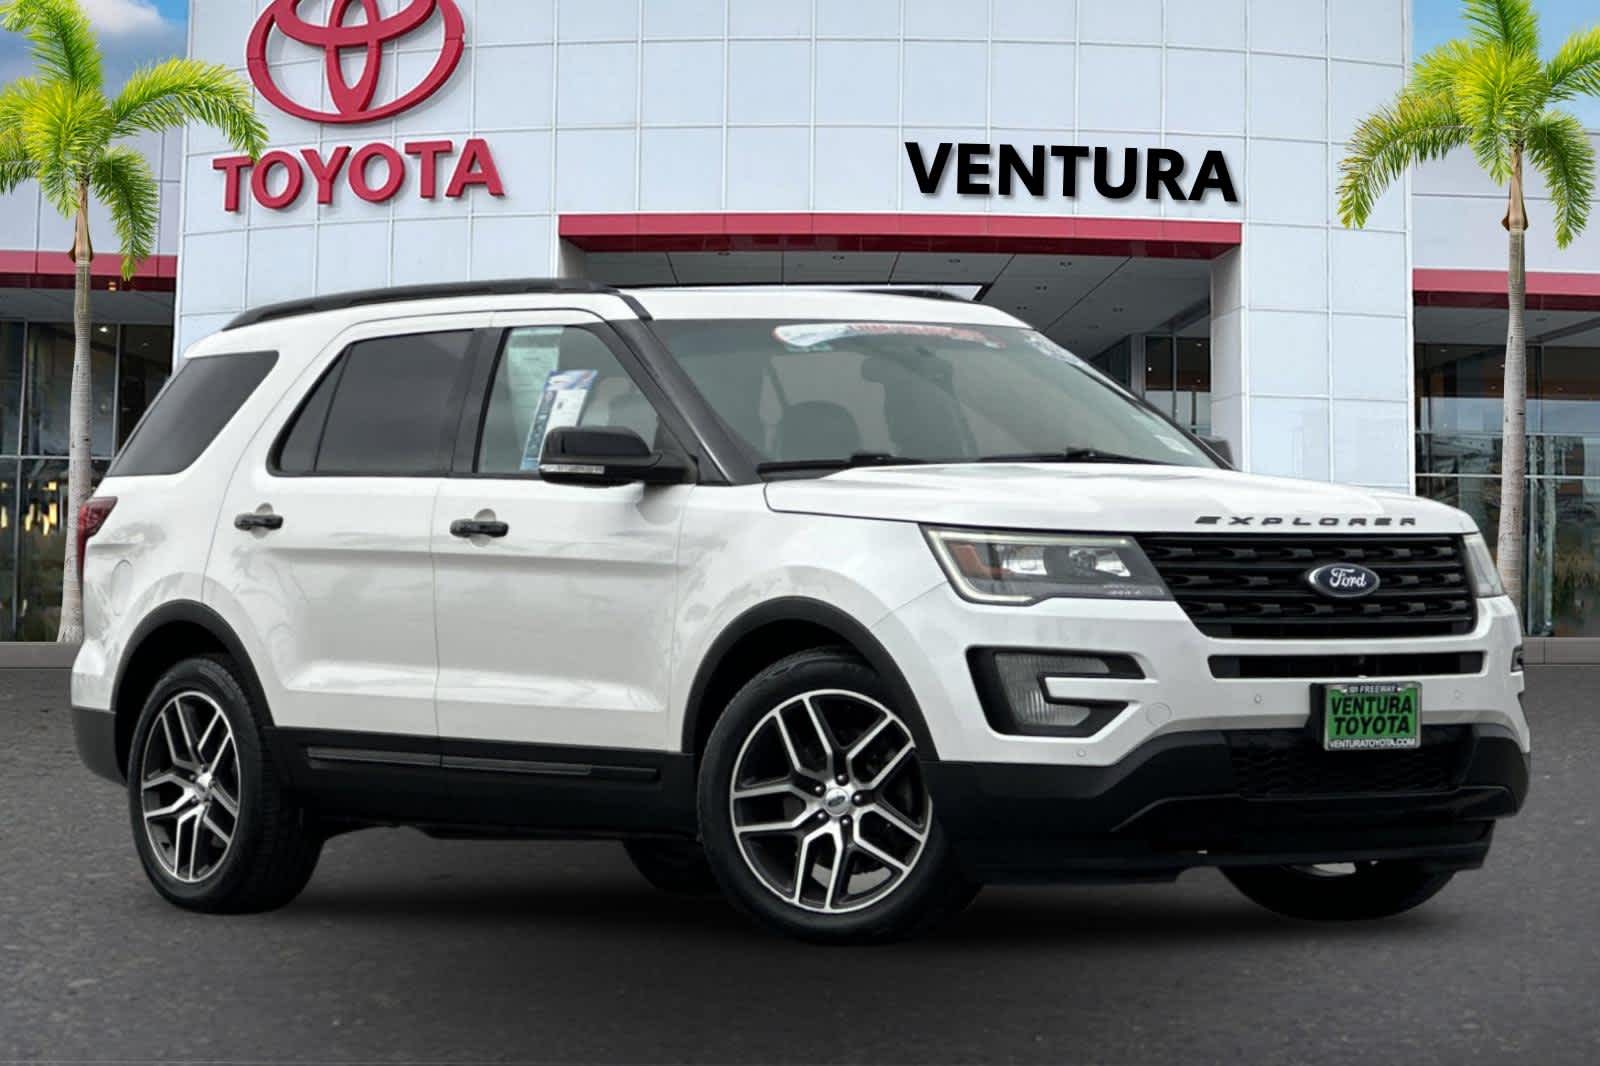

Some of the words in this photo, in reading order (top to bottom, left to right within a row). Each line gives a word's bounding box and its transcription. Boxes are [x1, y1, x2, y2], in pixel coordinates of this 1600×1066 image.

[213, 139, 505, 212] TOYOTA
[904, 142, 1239, 202] VENTURA
[1195, 516, 1416, 526] EXPLORER
[1329, 567, 1367, 588] Ford
[1331, 695, 1412, 715] VENTURA
[1334, 716, 1410, 735] TOYOTA
